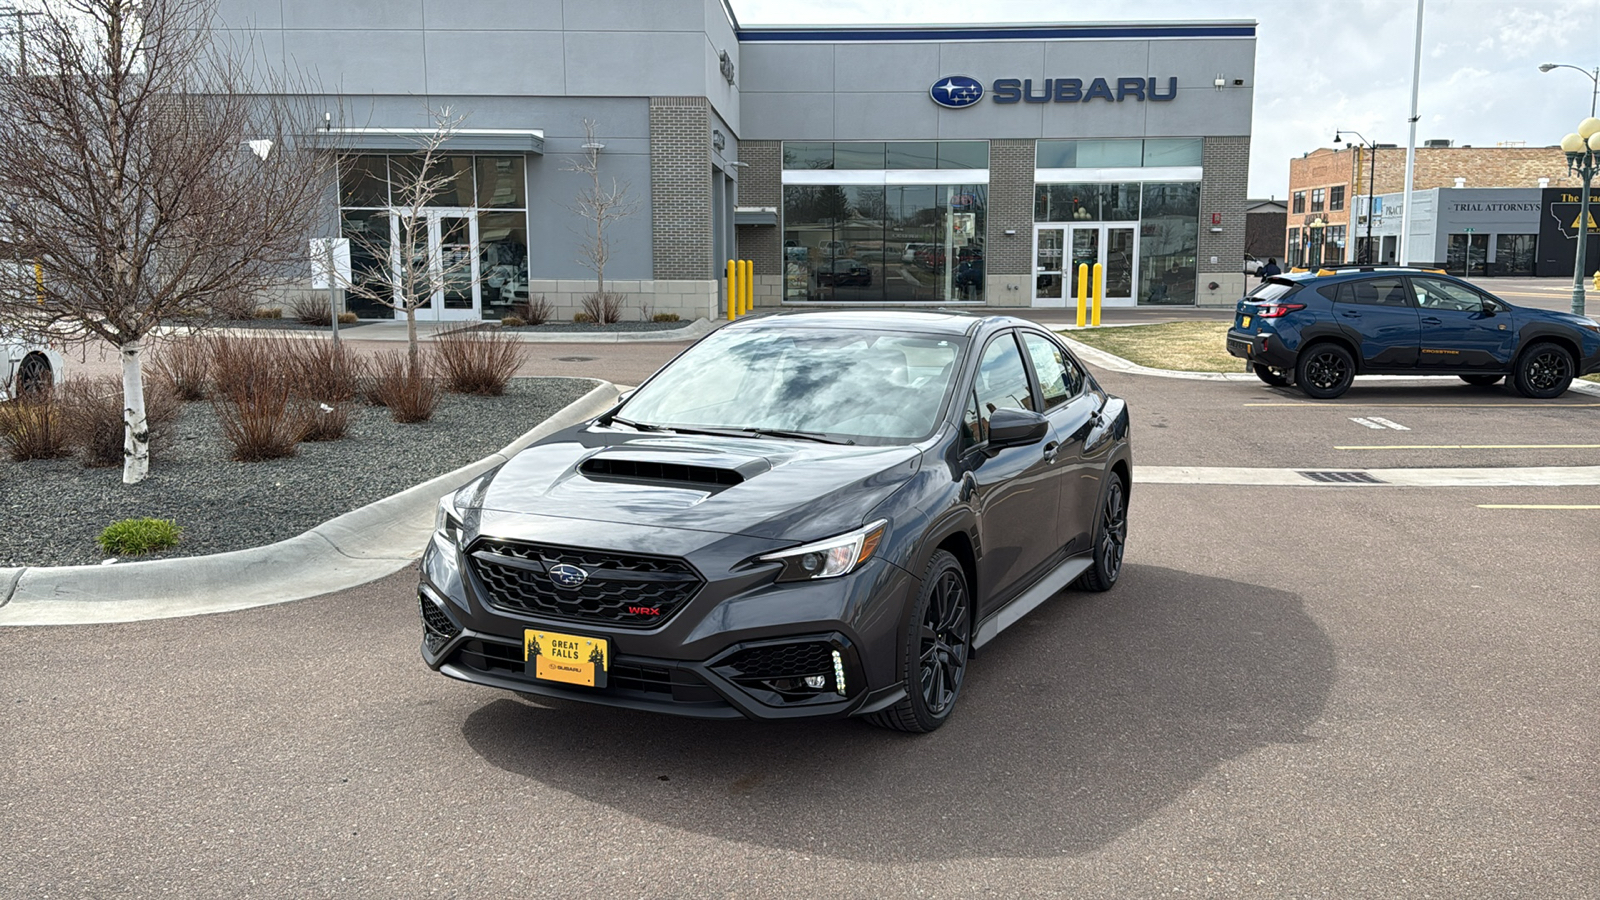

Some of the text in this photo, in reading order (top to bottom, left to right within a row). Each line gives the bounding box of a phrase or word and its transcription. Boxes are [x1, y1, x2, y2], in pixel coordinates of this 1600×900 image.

[993, 77, 1177, 104] SUBARU
[1560, 193, 1579, 202] The
[1385, 205, 1404, 216] PRACTI
[1454, 203, 1541, 211] TRIAL ATTORNEYS
[629, 606, 660, 615] WRX
[552, 640, 579, 650] GREAT
[552, 648, 579, 659] FALLS
